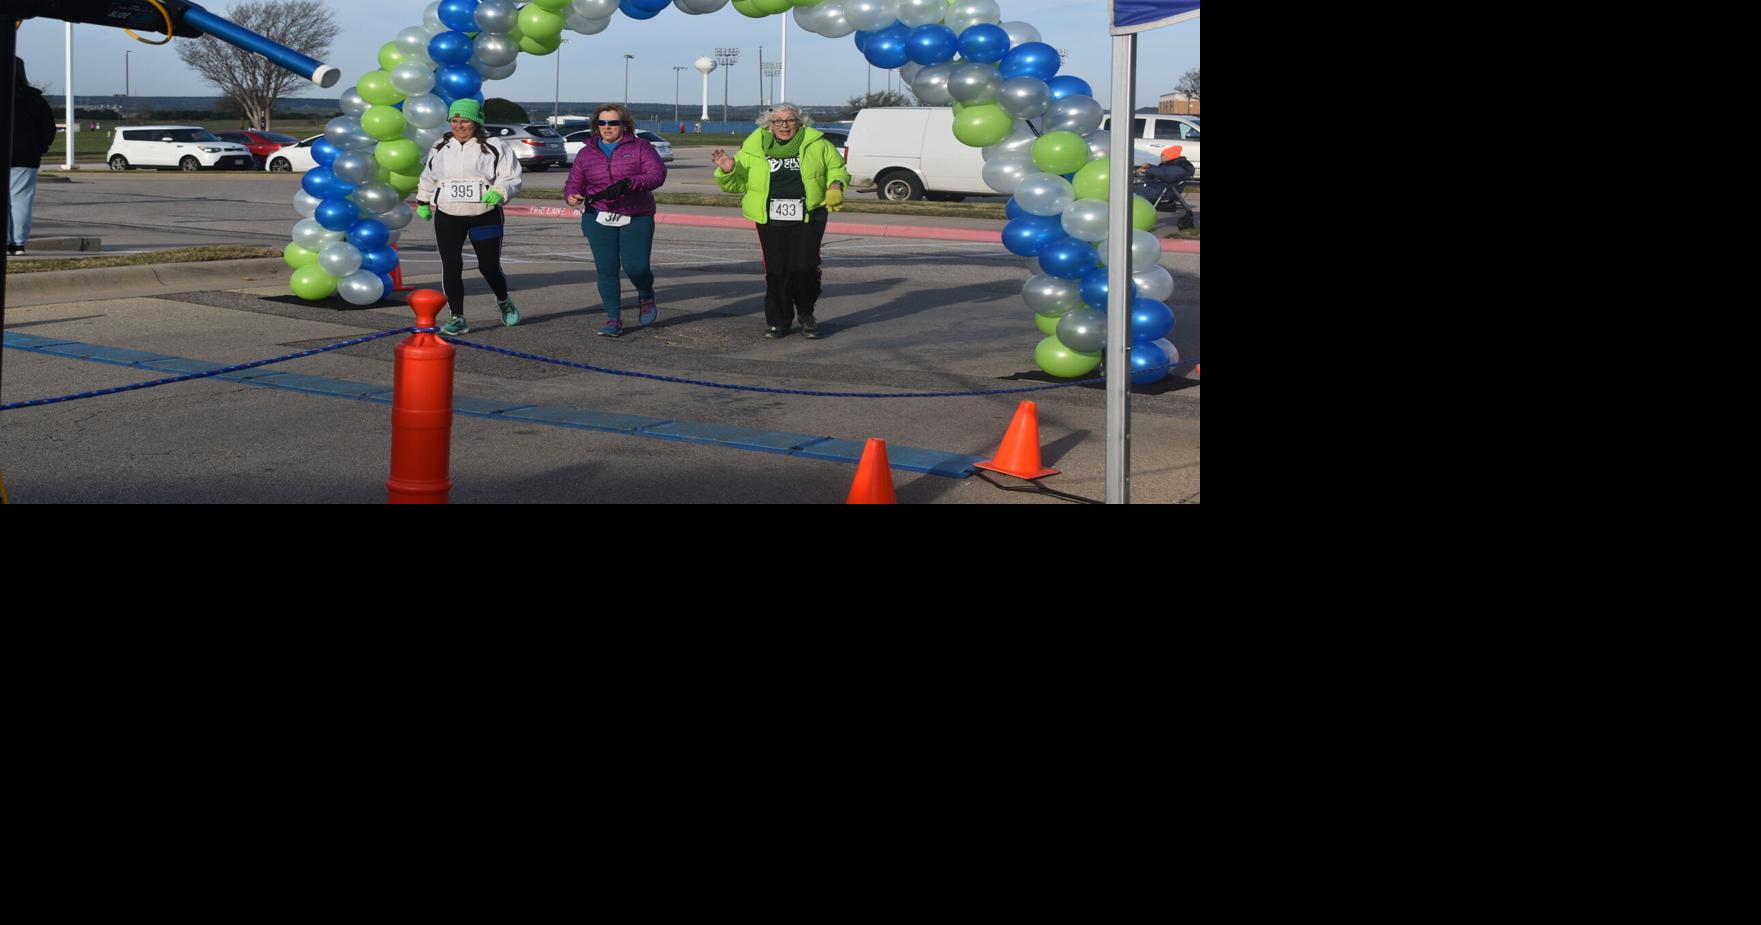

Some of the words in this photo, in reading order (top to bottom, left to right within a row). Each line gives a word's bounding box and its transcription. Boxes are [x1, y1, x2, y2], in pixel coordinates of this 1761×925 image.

[451, 184, 474, 198] 395
[546, 207, 566, 216] LANE
[775, 203, 796, 217] 433
